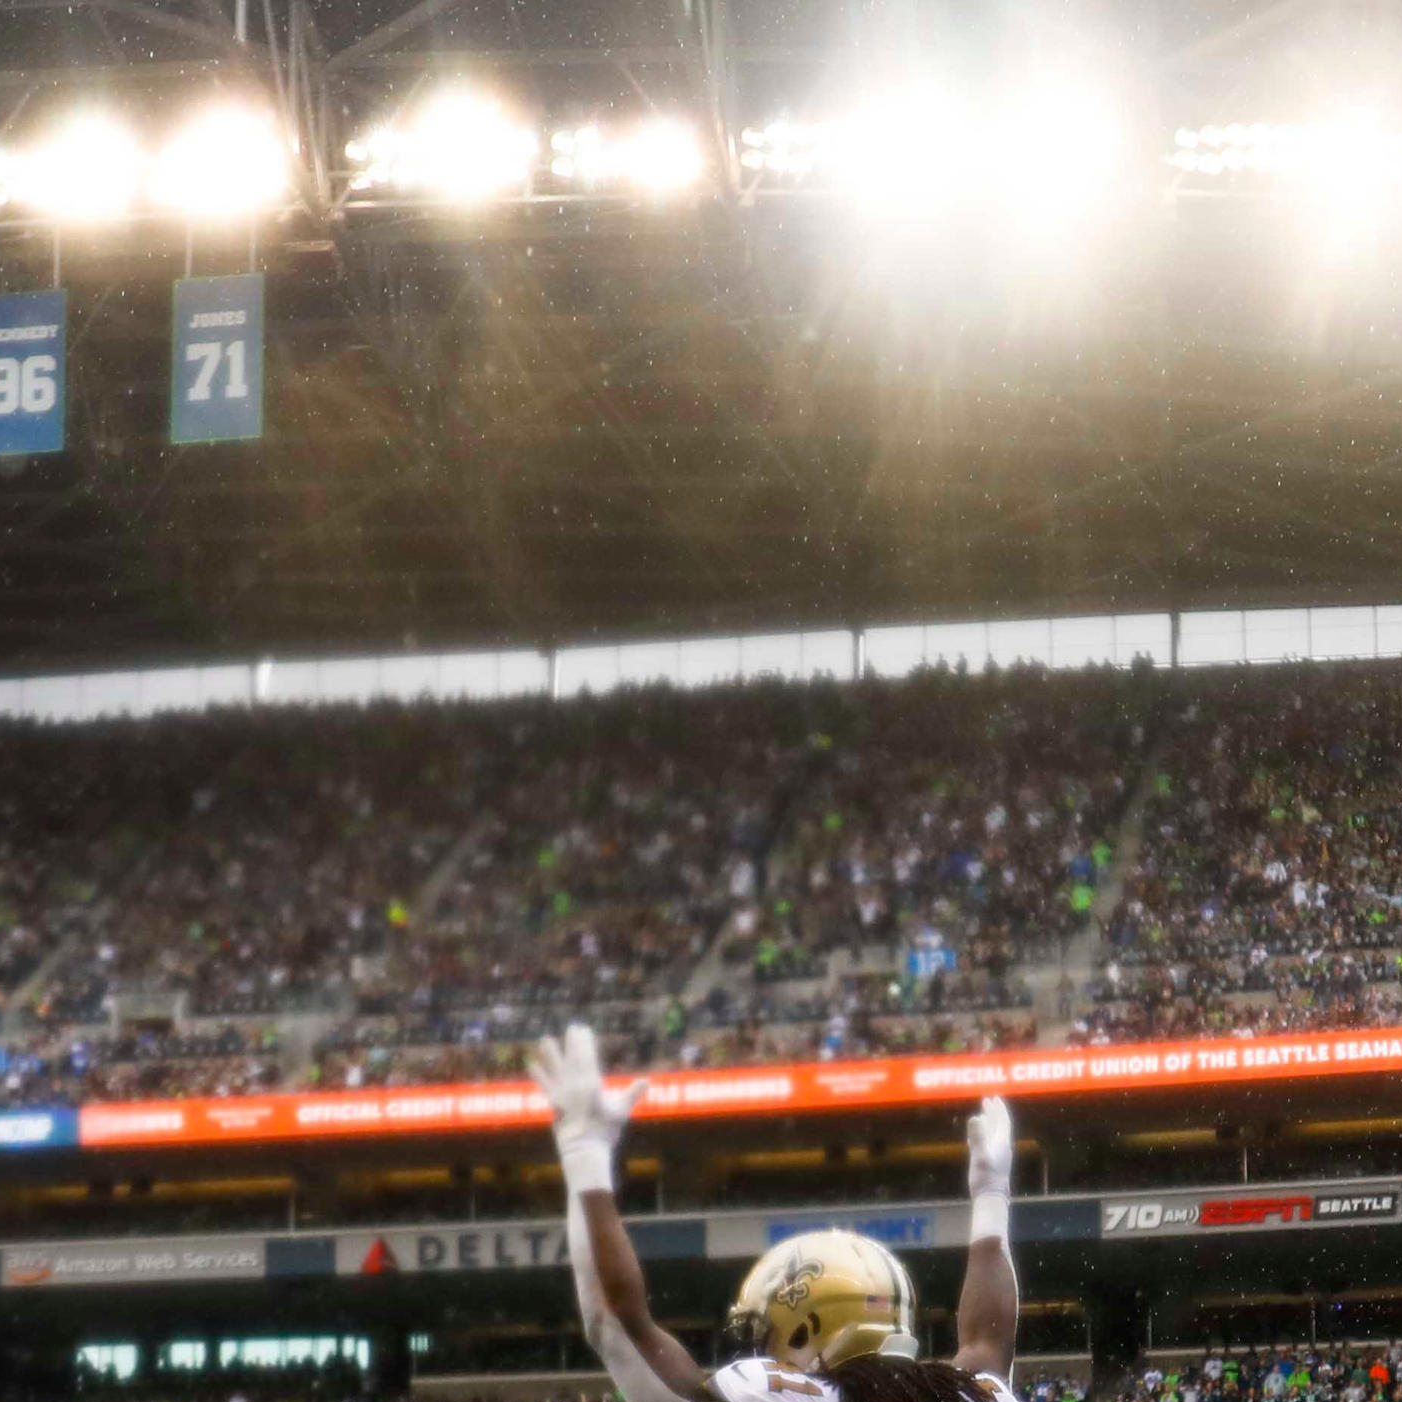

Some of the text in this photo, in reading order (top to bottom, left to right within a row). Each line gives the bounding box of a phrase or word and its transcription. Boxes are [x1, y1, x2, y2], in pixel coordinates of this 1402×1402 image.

[186, 340, 248, 401] 71
[914, 1066, 1007, 1088] OFFICIAL
[1011, 1059, 1084, 1082] CREDIT
[1090, 1055, 1158, 1076] UNION
[1164, 1052, 1192, 1072] OF
[1197, 1049, 1237, 1069] THE
[1243, 1042, 1330, 1068] SEATTLE
[299, 1101, 383, 1124] OFFICIAL
[386, 1096, 453, 1119] CREDIT
[459, 1093, 522, 1114] UNION
[1102, 1195, 1394, 1232] 710 AM ESPN SEATTLE
[54, 1248, 261, 1276] Amazon Web Services
